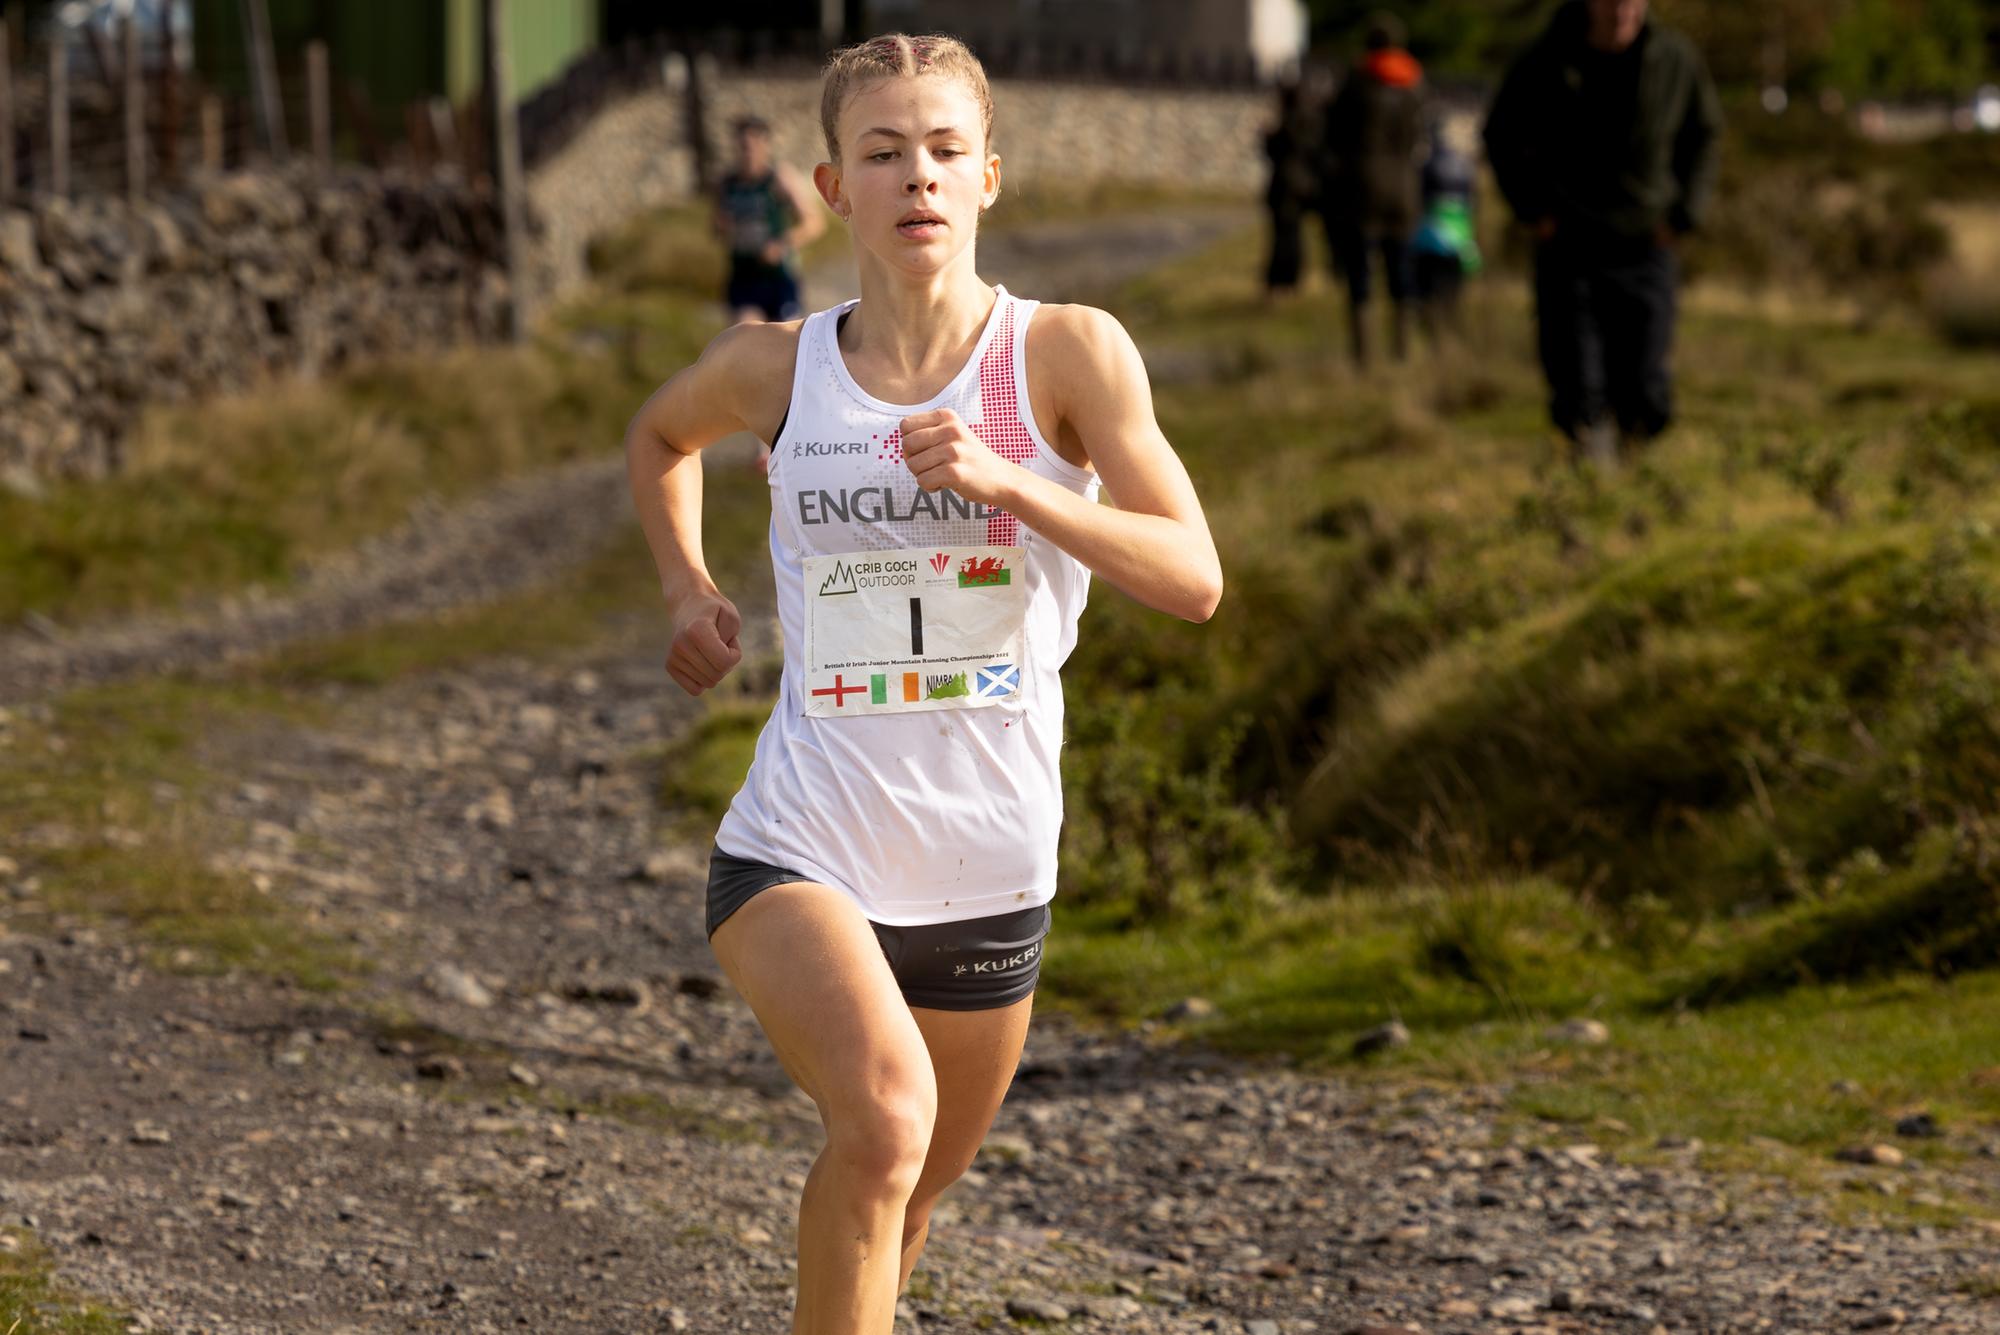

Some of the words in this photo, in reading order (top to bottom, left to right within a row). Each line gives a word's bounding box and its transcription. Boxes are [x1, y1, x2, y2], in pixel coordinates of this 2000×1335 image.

[805, 442, 869, 457] KUKRI
[855, 562, 882, 574] CRIB
[884, 560, 917, 572] GOCH
[859, 574, 916, 588] OUTDOOR
[823, 662, 845, 670] British
[868, 659, 890, 667] Junior
[890, 658, 921, 666] Mountain
[950, 653, 995, 662] Championships
[973, 942, 1040, 973] KUKRI
